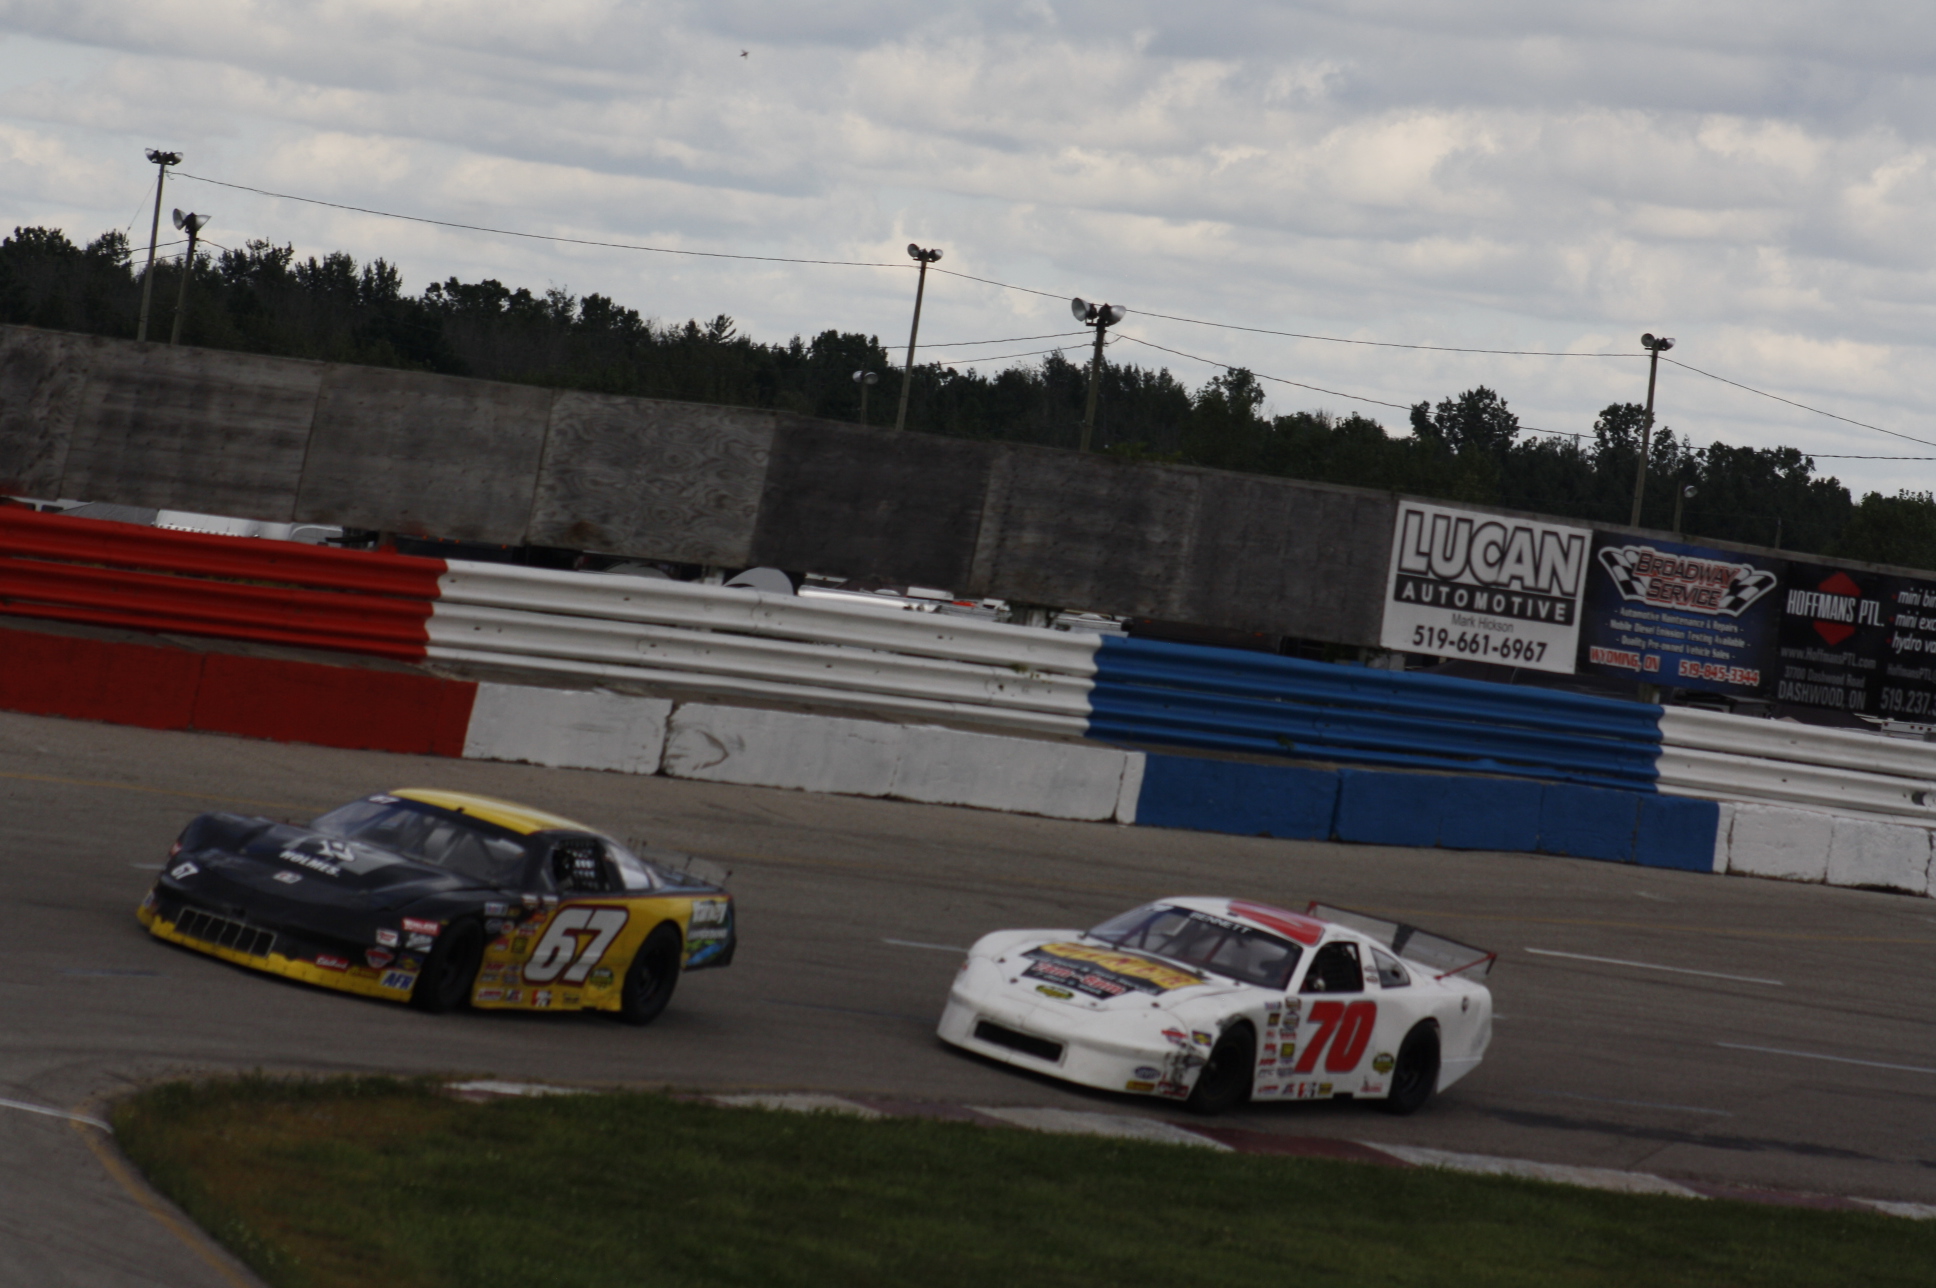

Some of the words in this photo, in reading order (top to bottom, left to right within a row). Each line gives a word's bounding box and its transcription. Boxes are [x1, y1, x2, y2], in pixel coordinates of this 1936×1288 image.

[1397, 509, 1585, 597] LUCAN
[1633, 550, 1741, 588] BROADWAY
[1402, 581, 1566, 621] AUTOMOTIVE
[1647, 577, 1723, 610] SERVICE
[1786, 589, 1856, 623] HOFFMANS
[1858, 600, 1885, 627] PTL.
[1897, 587, 1921, 606] mini
[1451, 613, 1475, 627] Mark
[1479, 616, 1514, 633] Hickson
[1894, 610, 1918, 629] mini
[1413, 625, 1548, 663] 519-661-6967
[1891, 630, 1922, 655] hydro
[1590, 646, 1642, 672] WYOMING,
[1643, 654, 1661, 672] ON
[1678, 659, 1760, 686] 519-845-3344
[1778, 680, 1845, 710] DASHWOOD,
[1848, 690, 1867, 711] ON
[1846, 673, 1866, 689] Road
[1189, 911, 1252, 934] BENNETT
[522, 904, 628, 986] 67
[1294, 1000, 1377, 1074] 70
